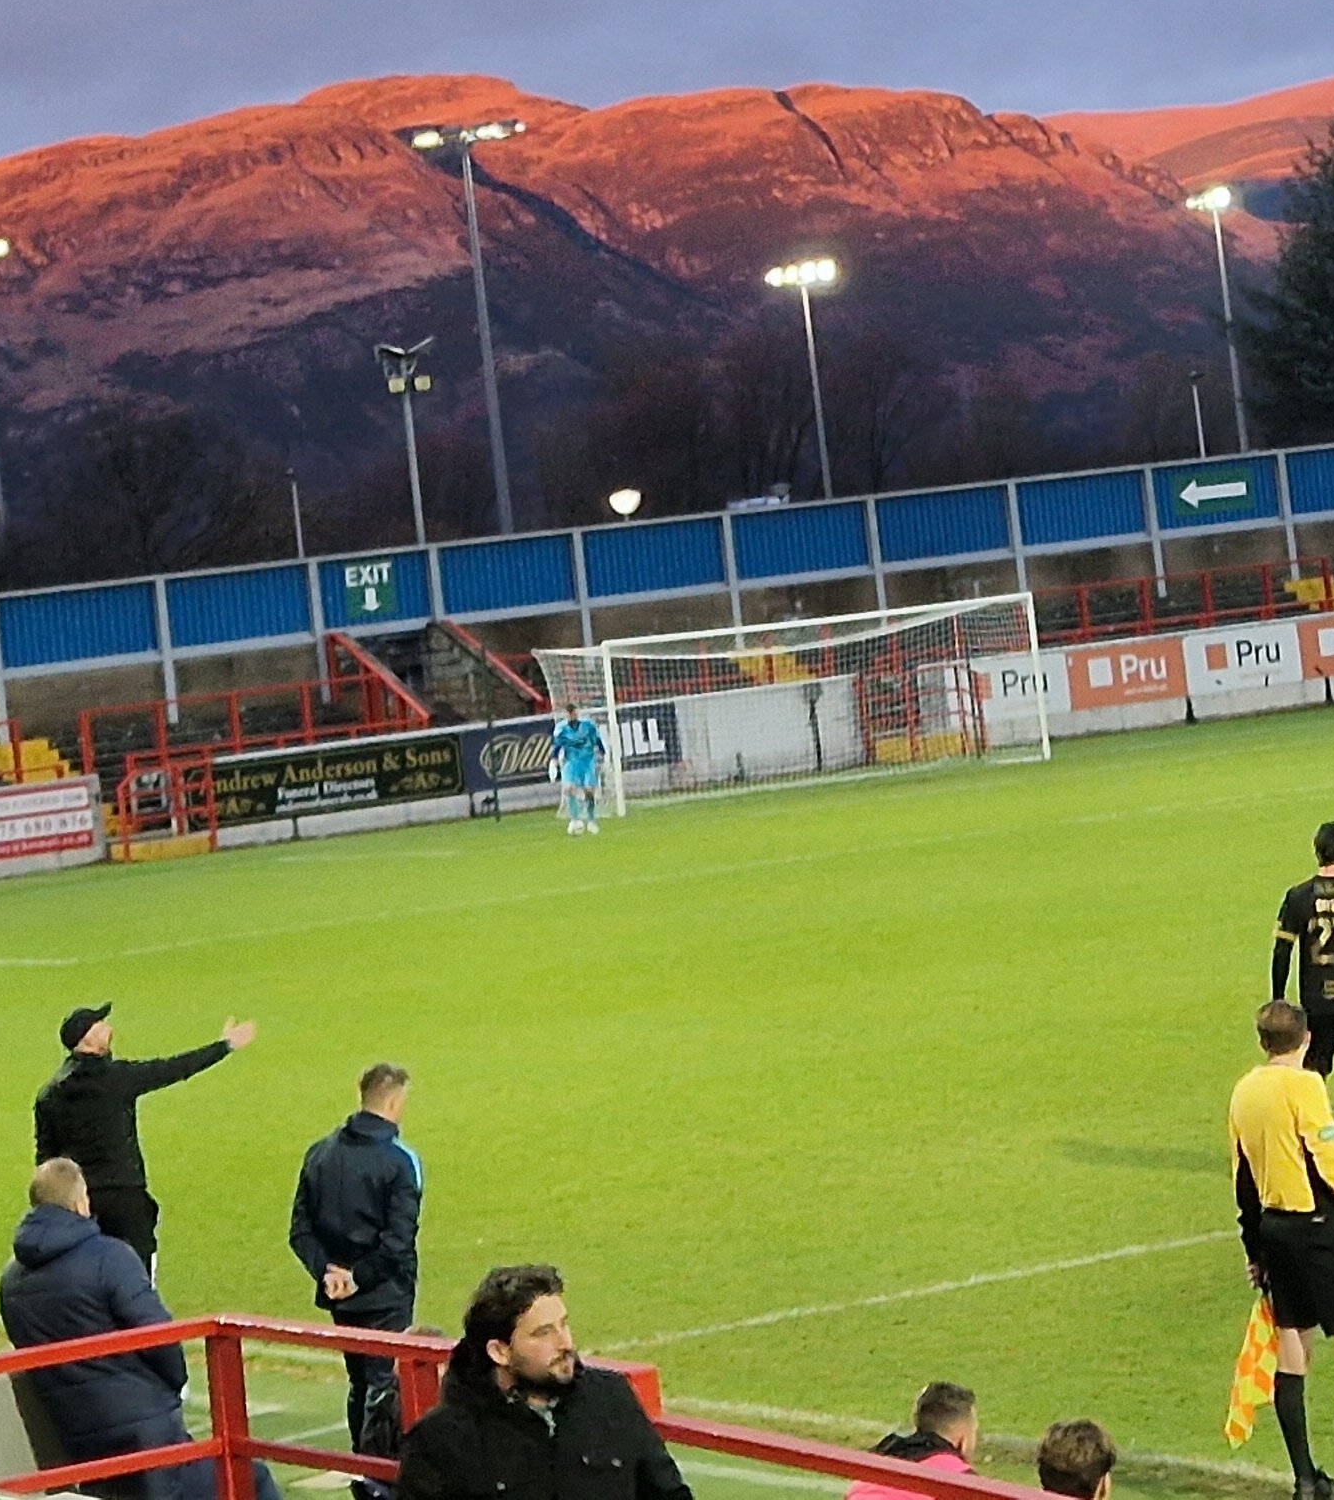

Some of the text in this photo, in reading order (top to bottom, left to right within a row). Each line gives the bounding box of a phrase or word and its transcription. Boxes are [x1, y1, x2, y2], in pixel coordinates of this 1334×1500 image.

[344, 561, 392, 588] EXIT
[1235, 639, 1281, 667] Pru
[1120, 653, 1167, 684] Pru
[1000, 669, 1048, 697] Pru
[282, 755, 377, 786] Anderson
[382, 751, 402, 772] &
[405, 747, 452, 768] Sons
